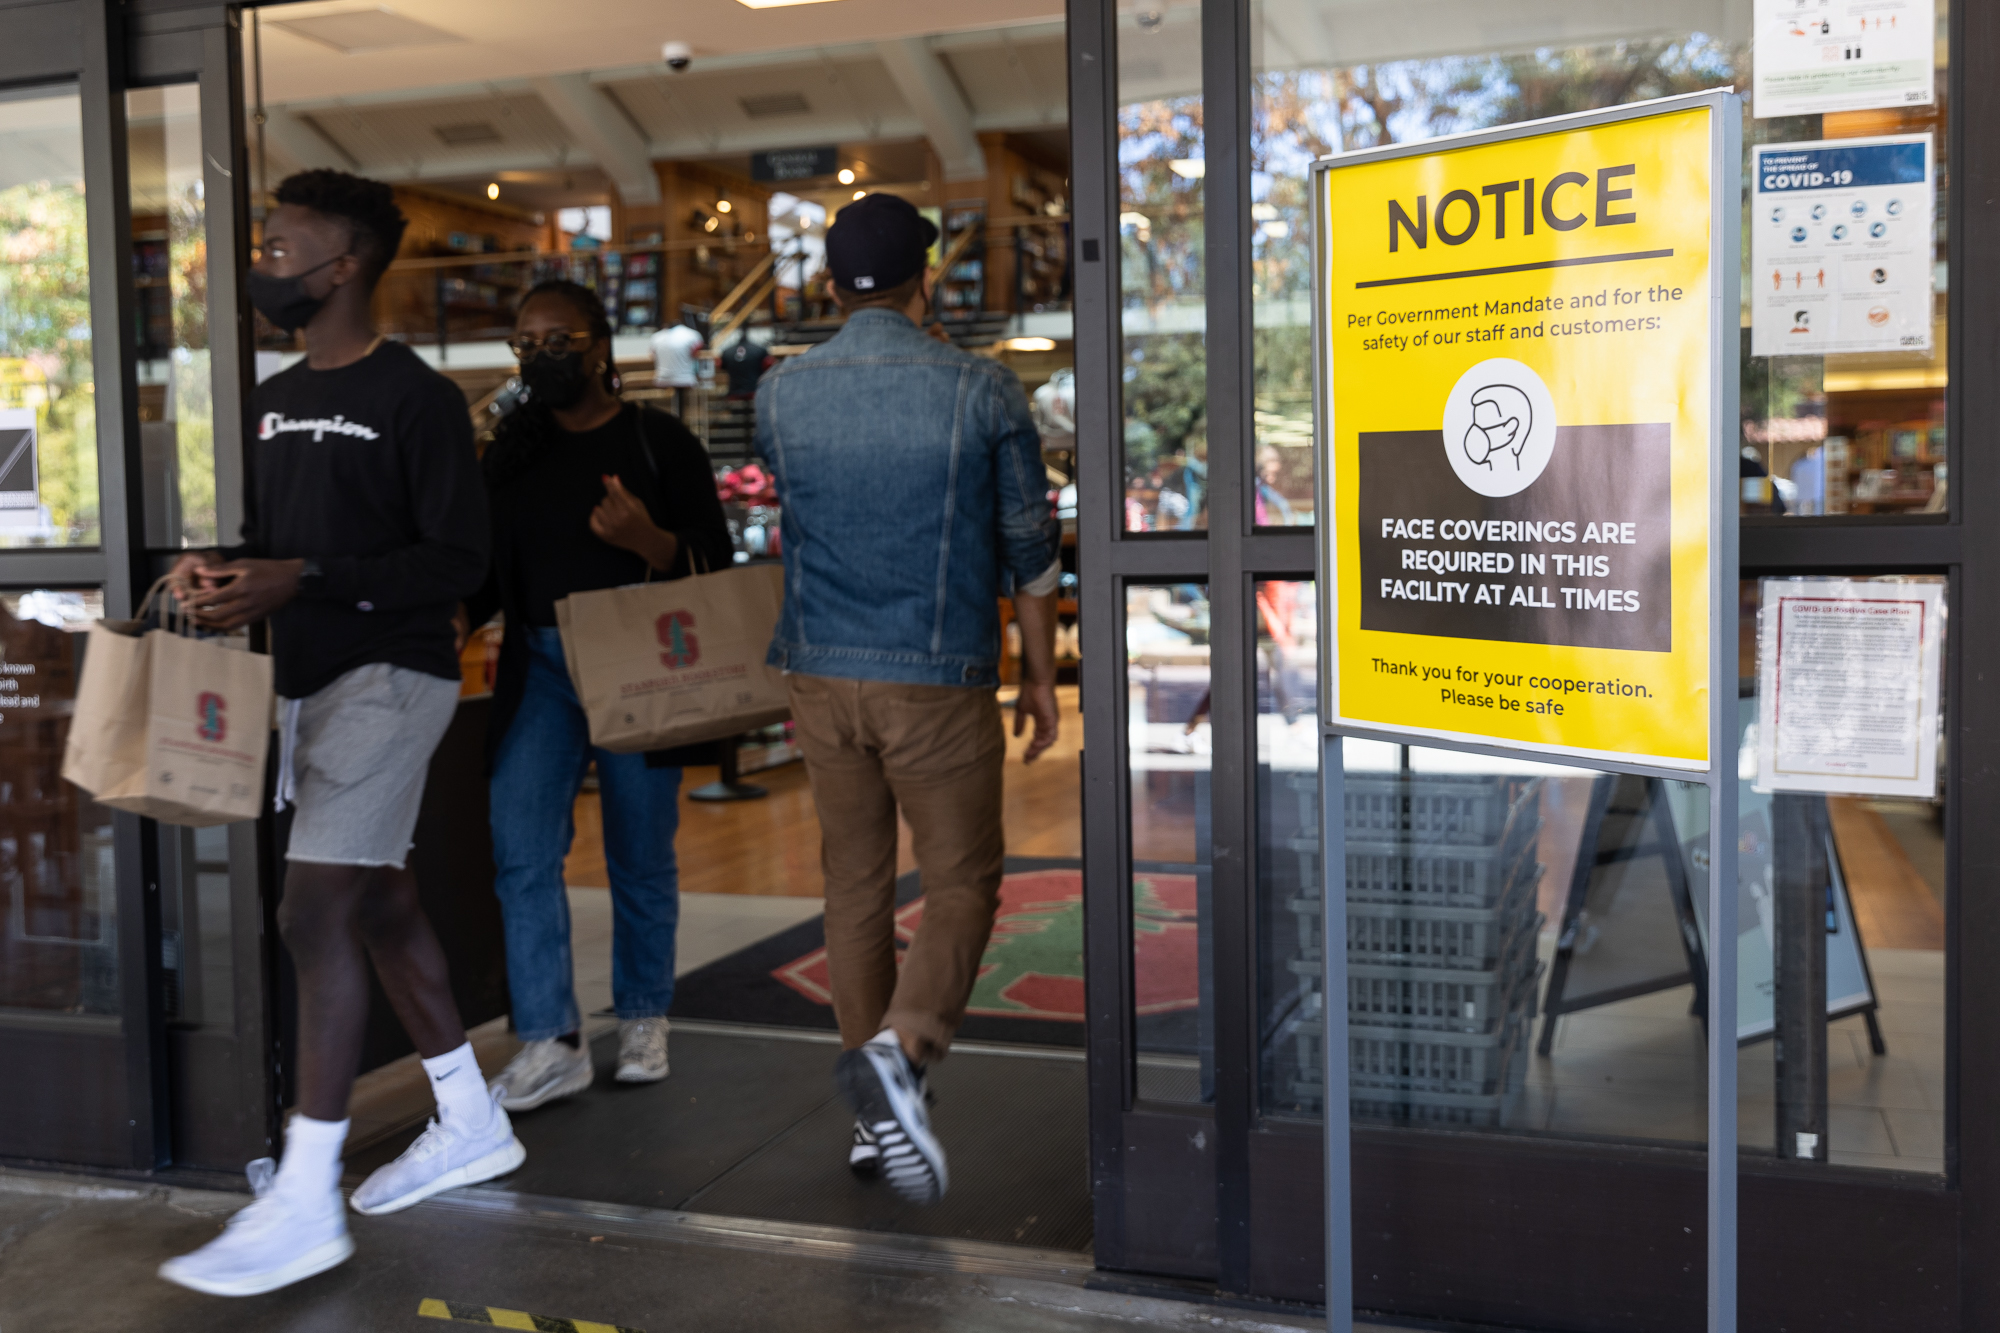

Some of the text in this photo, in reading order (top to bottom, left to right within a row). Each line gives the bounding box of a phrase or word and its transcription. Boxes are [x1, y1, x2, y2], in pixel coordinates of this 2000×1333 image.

[1763, 162, 1819, 173] THE SPREAD OF
[1764, 169, 1853, 189] COVID-19
[1387, 163, 1637, 254] NOTICE
[1347, 284, 1683, 328] Per Government Mandate and for the
[1362, 316, 1661, 352] safety of our staff and customers:
[1381, 518, 1637, 545] FACE COVERINGS ARE
[1401, 548, 1610, 578] REQUIRED IN THIS
[1380, 578, 1641, 613] FACILITY AT ALL TIMES
[1371, 657, 1653, 699] Thank you for your cooperation.
[1440, 688, 1565, 716] Please be safe
